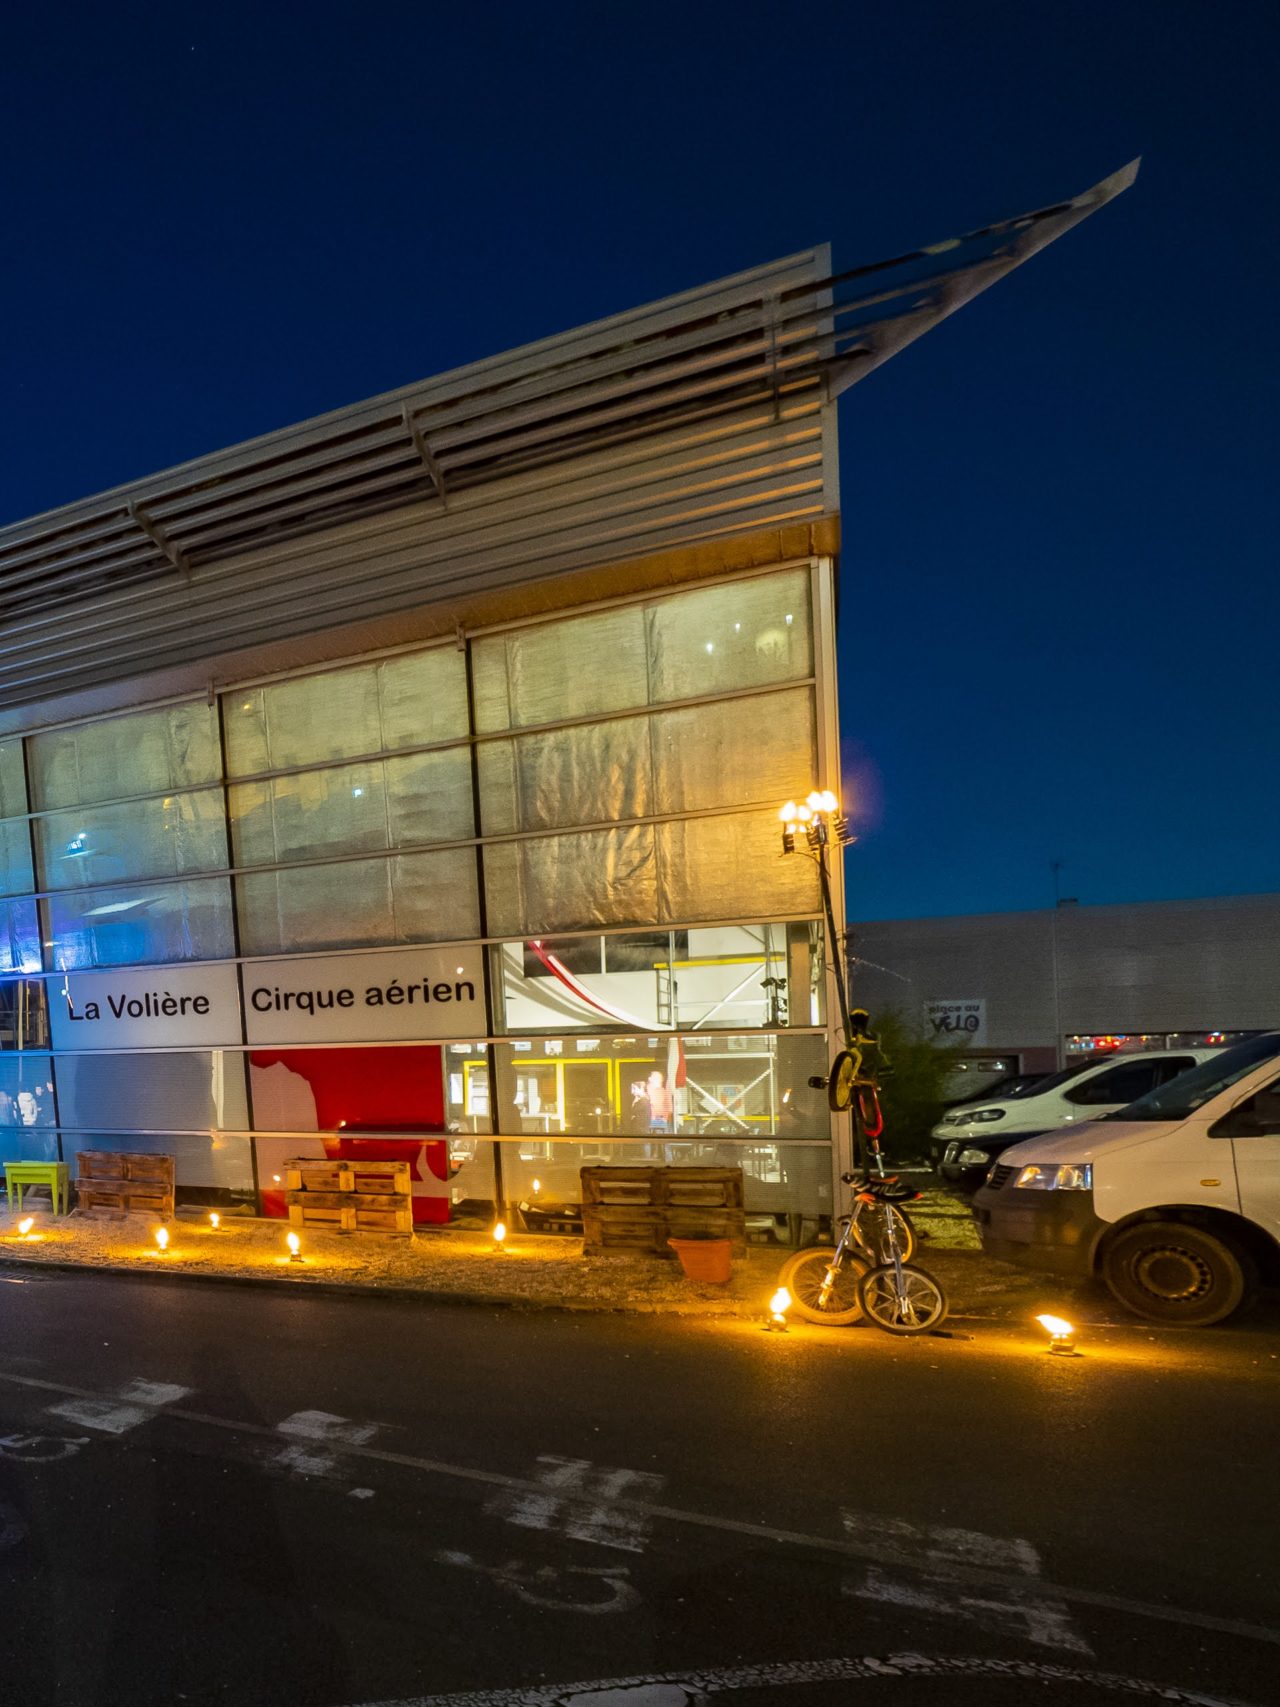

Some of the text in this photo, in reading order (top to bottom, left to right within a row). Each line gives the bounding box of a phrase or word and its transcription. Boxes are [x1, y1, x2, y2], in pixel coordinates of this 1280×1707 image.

[68, 991, 210, 1021] La Volière
[251, 977, 475, 1016] Cirque aérien
[964, 1004, 980, 1012] au
